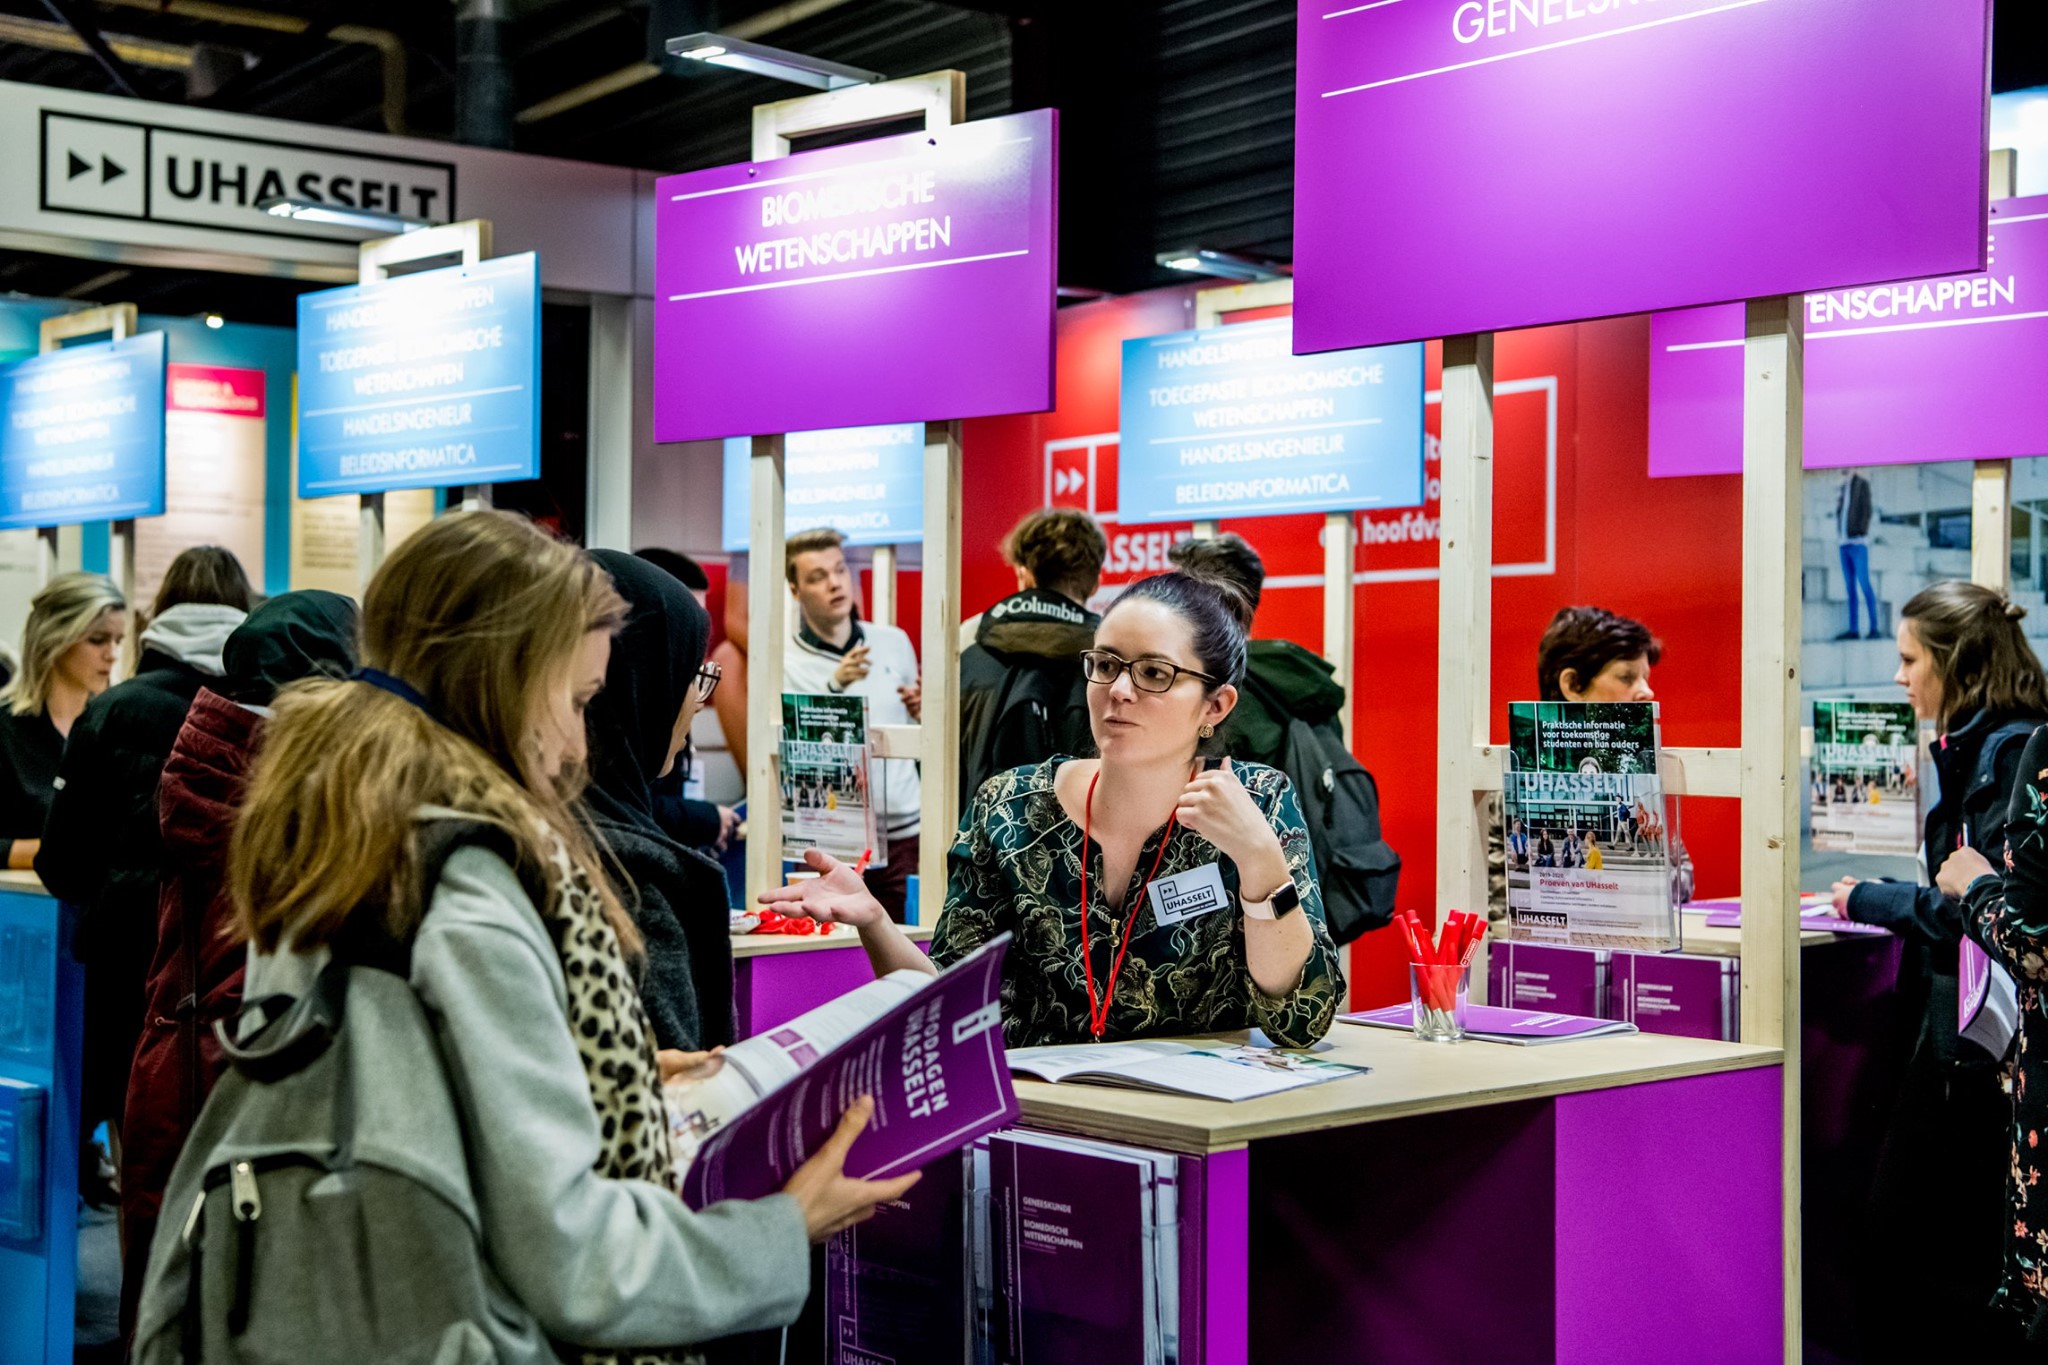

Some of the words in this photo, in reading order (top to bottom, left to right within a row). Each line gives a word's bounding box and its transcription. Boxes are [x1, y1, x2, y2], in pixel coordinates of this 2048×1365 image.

[166, 155, 438, 219] UHASSELT
[734, 215, 951, 275] WETENSCHAPPEN
[1179, 433, 1345, 467] HANDELSINGENIEUR
[1175, 472, 1351, 504] BELEIDSINFORMATICA
[1006, 595, 1085, 625] Columbia
[1542, 720, 1583, 730] Praktische
[1542, 731, 1560, 739] voor
[1561, 730, 1610, 740] toekomstige
[1543, 739, 1582, 748] studenten
[1594, 739, 1610, 749] hun
[1611, 740, 1640, 750] ouders
[1540, 879, 1570, 888] Proeven
[1586, 880, 1619, 891] UHasselt
[1166, 890, 1212, 910] UHASSELT
[1519, 914, 1566, 926] UHASSELT
[1023, 1229, 1084, 1250] WETENSCHAPPEN
